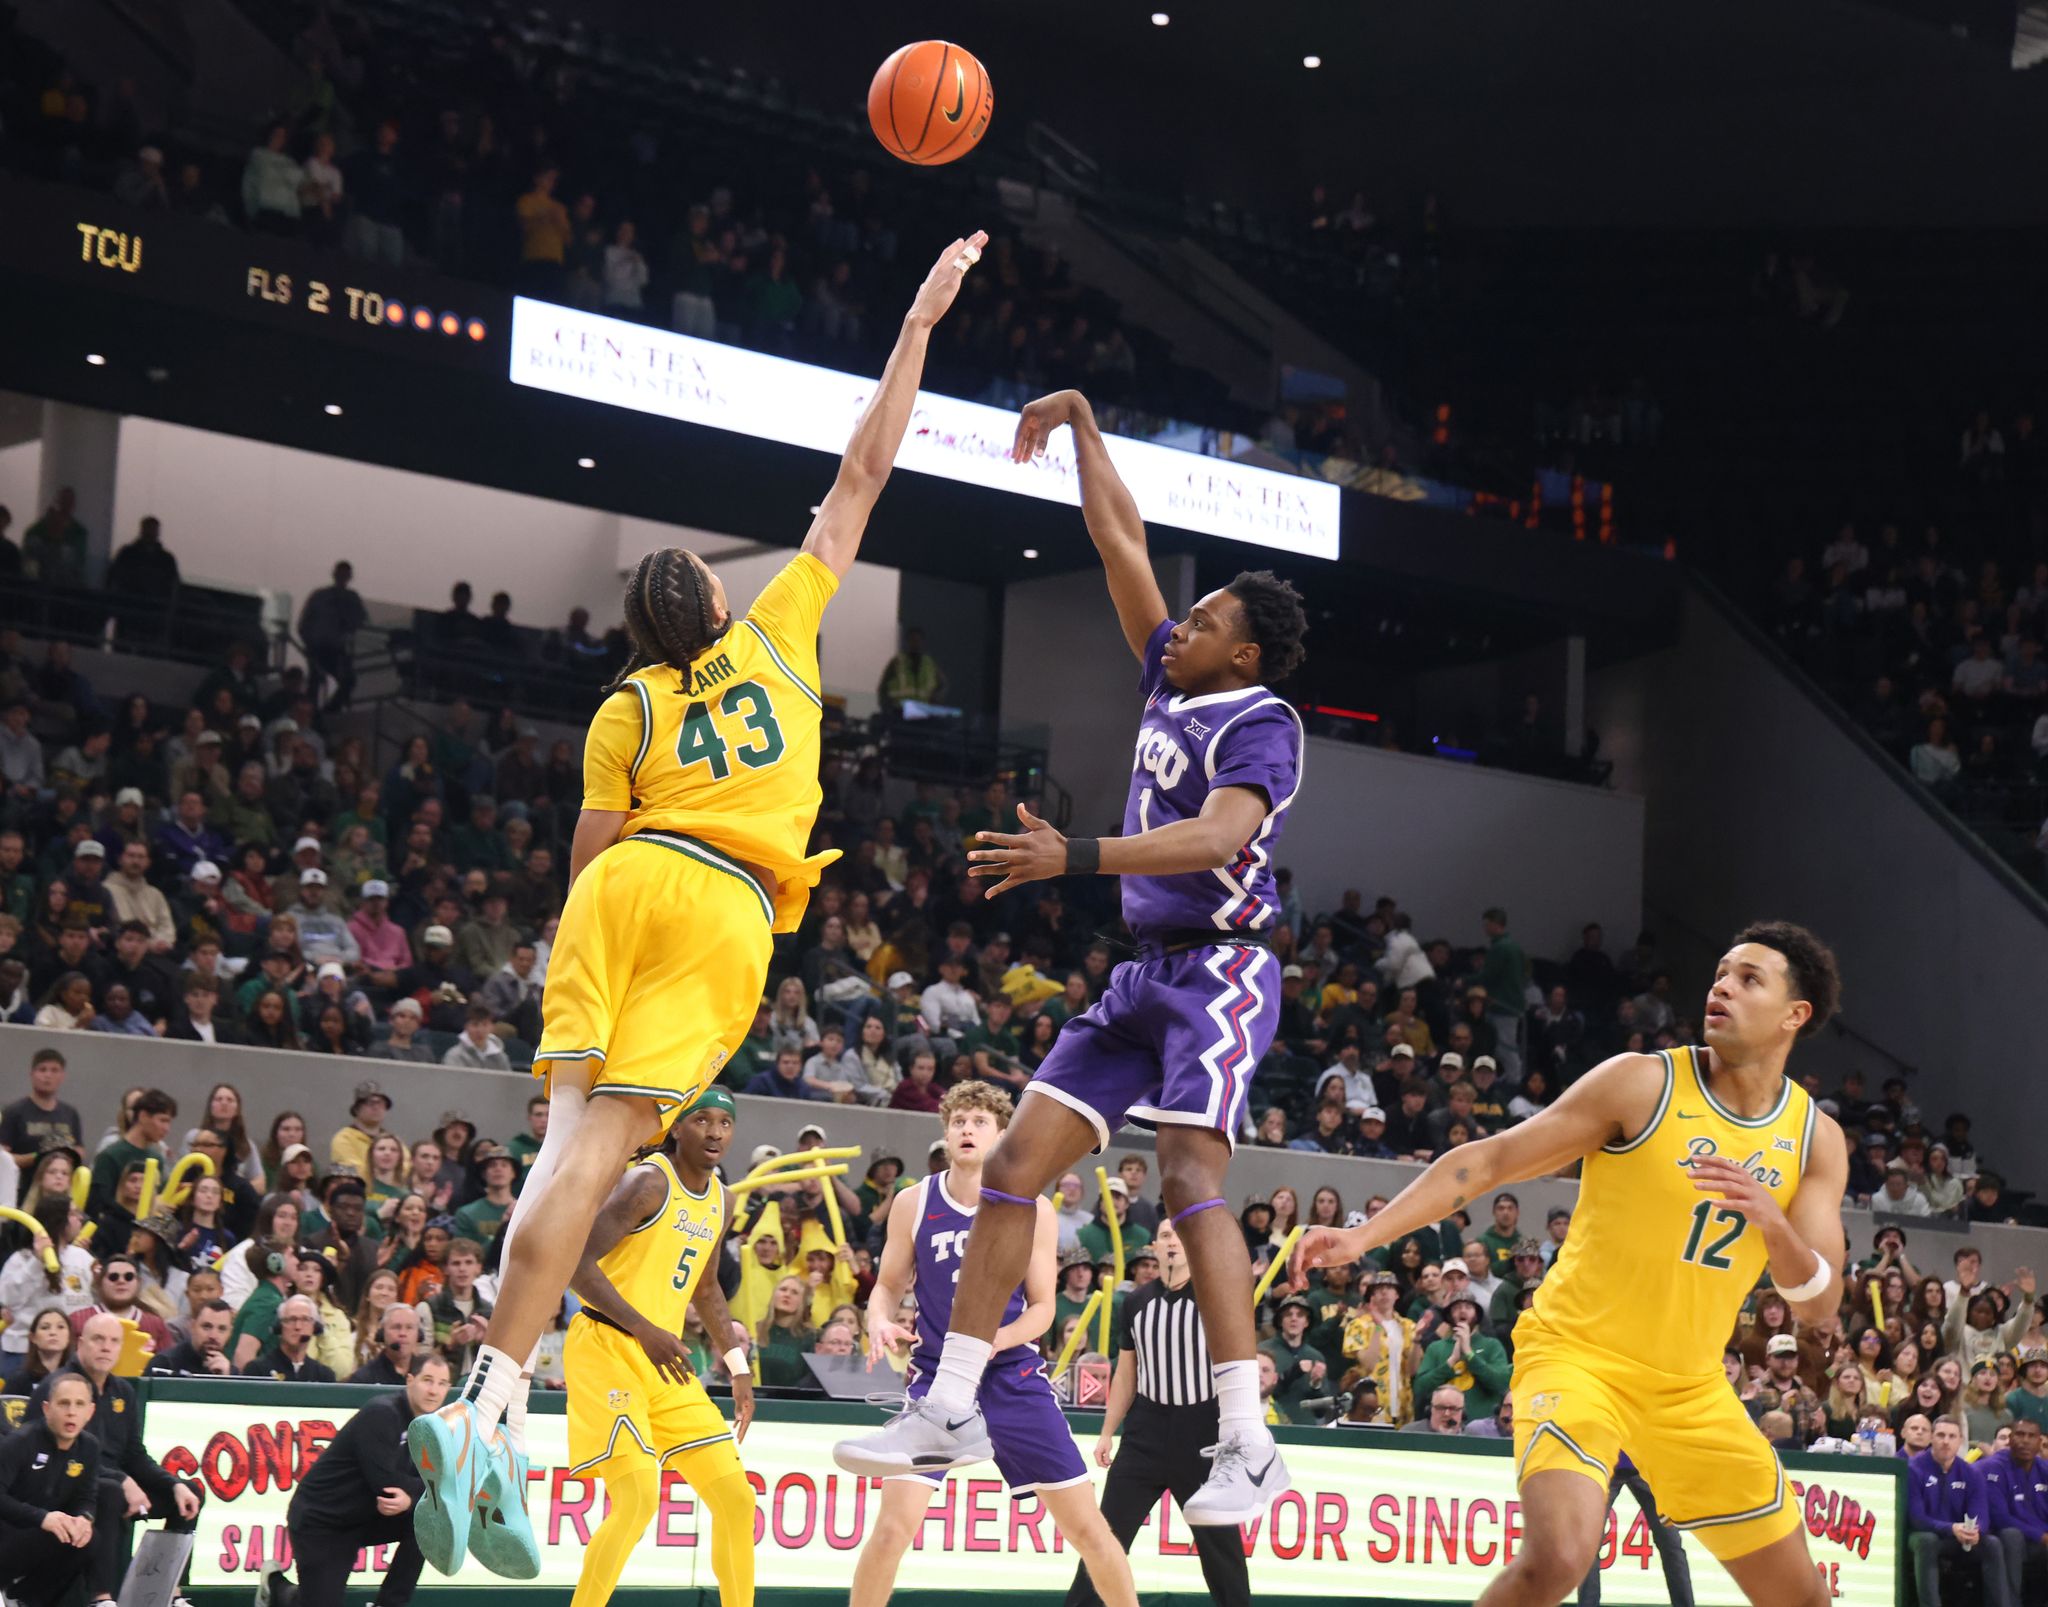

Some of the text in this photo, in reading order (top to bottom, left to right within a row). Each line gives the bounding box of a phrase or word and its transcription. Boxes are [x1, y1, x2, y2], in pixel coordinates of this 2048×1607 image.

[77, 222, 143, 273] TCU
[247, 266, 384, 326] FLS 2 TO
[529, 348, 728, 406] ROOF SYSTEMS
[676, 680, 786, 781] 43
[1139, 788, 1152, 833] 1
[1677, 1136, 1783, 1188] Blor
[673, 1208, 713, 1241] Baylor
[1681, 1199, 1748, 1271] 12
[672, 1246, 698, 1291] 5
